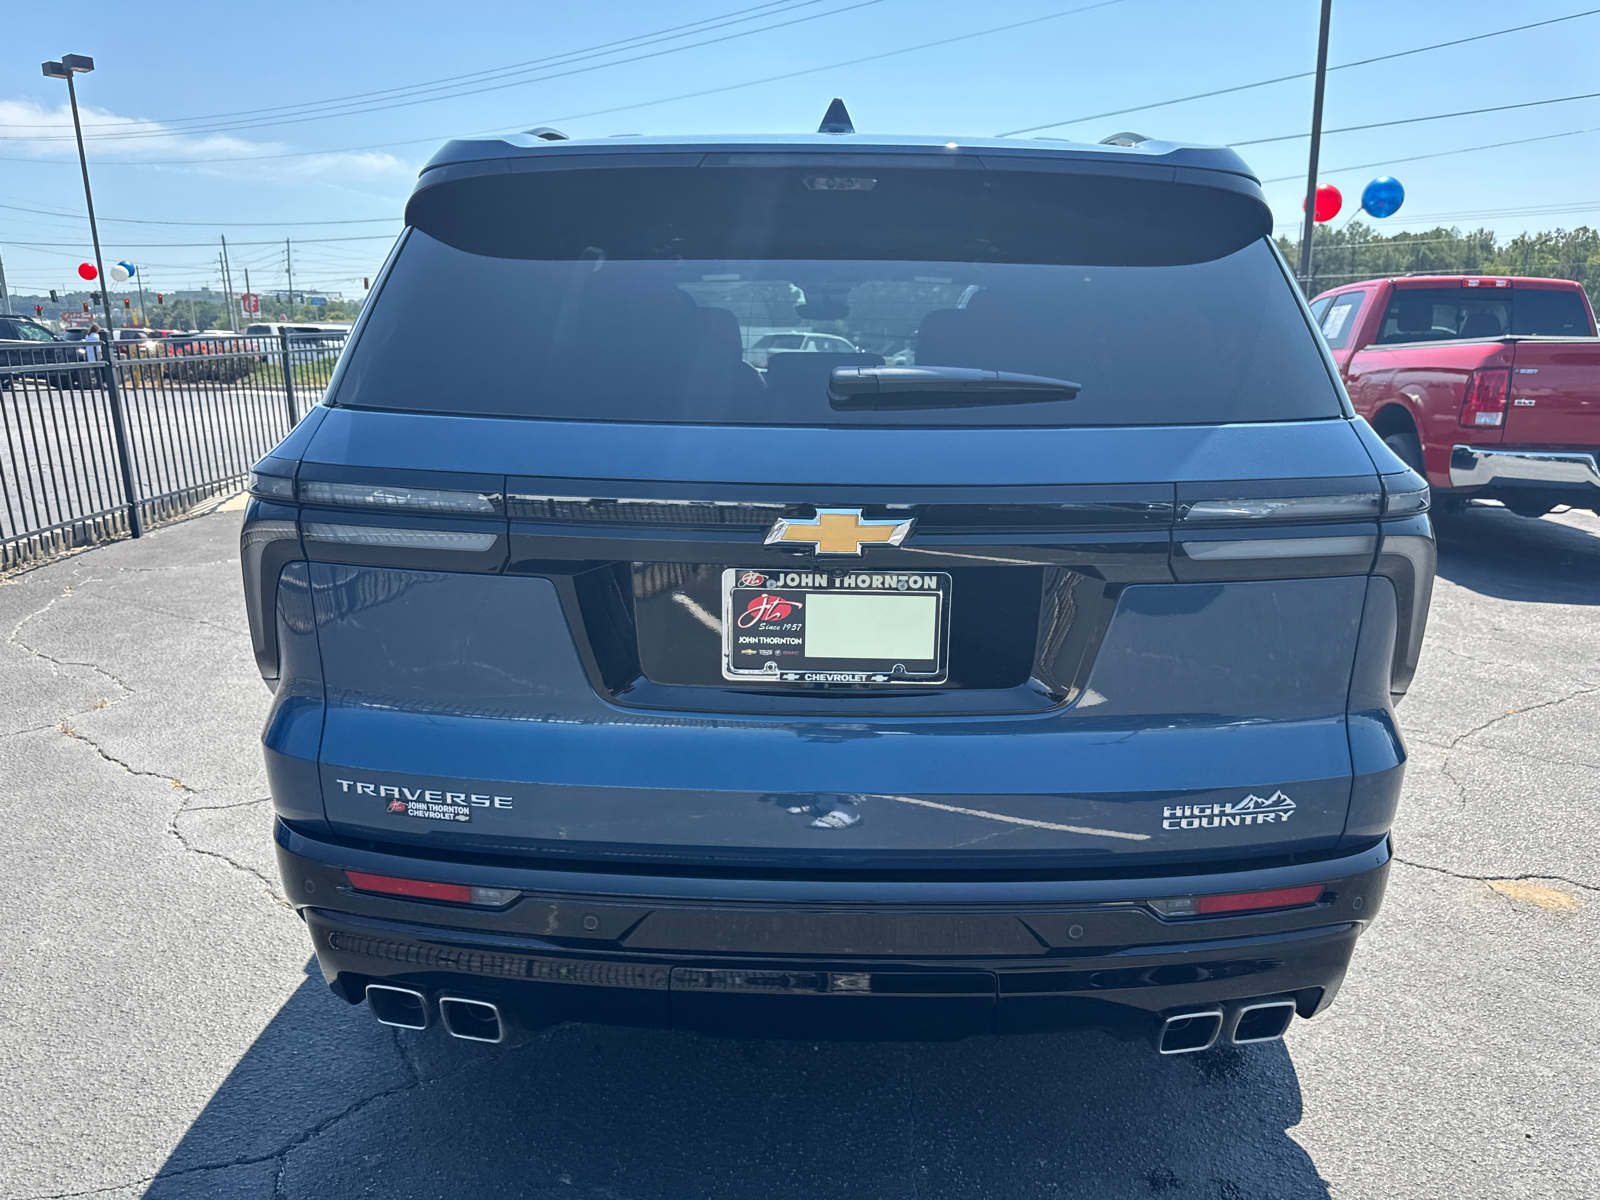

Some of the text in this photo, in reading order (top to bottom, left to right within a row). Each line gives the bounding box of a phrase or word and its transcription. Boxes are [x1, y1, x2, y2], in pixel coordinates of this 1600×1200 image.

[777, 573, 828, 587] JOHN
[758, 622, 803, 631] Since 1957
[738, 636, 803, 645] JOHN THORNTON
[804, 673, 867, 682] CHEVROLET
[336, 779, 513, 809] TRAVERSE
[408, 801, 469, 815] JOHN THORNTON
[408, 809, 455, 821] CHEVROLET
[1163, 802, 1233, 817] HIGH
[1162, 810, 1295, 830] COUNTRY
